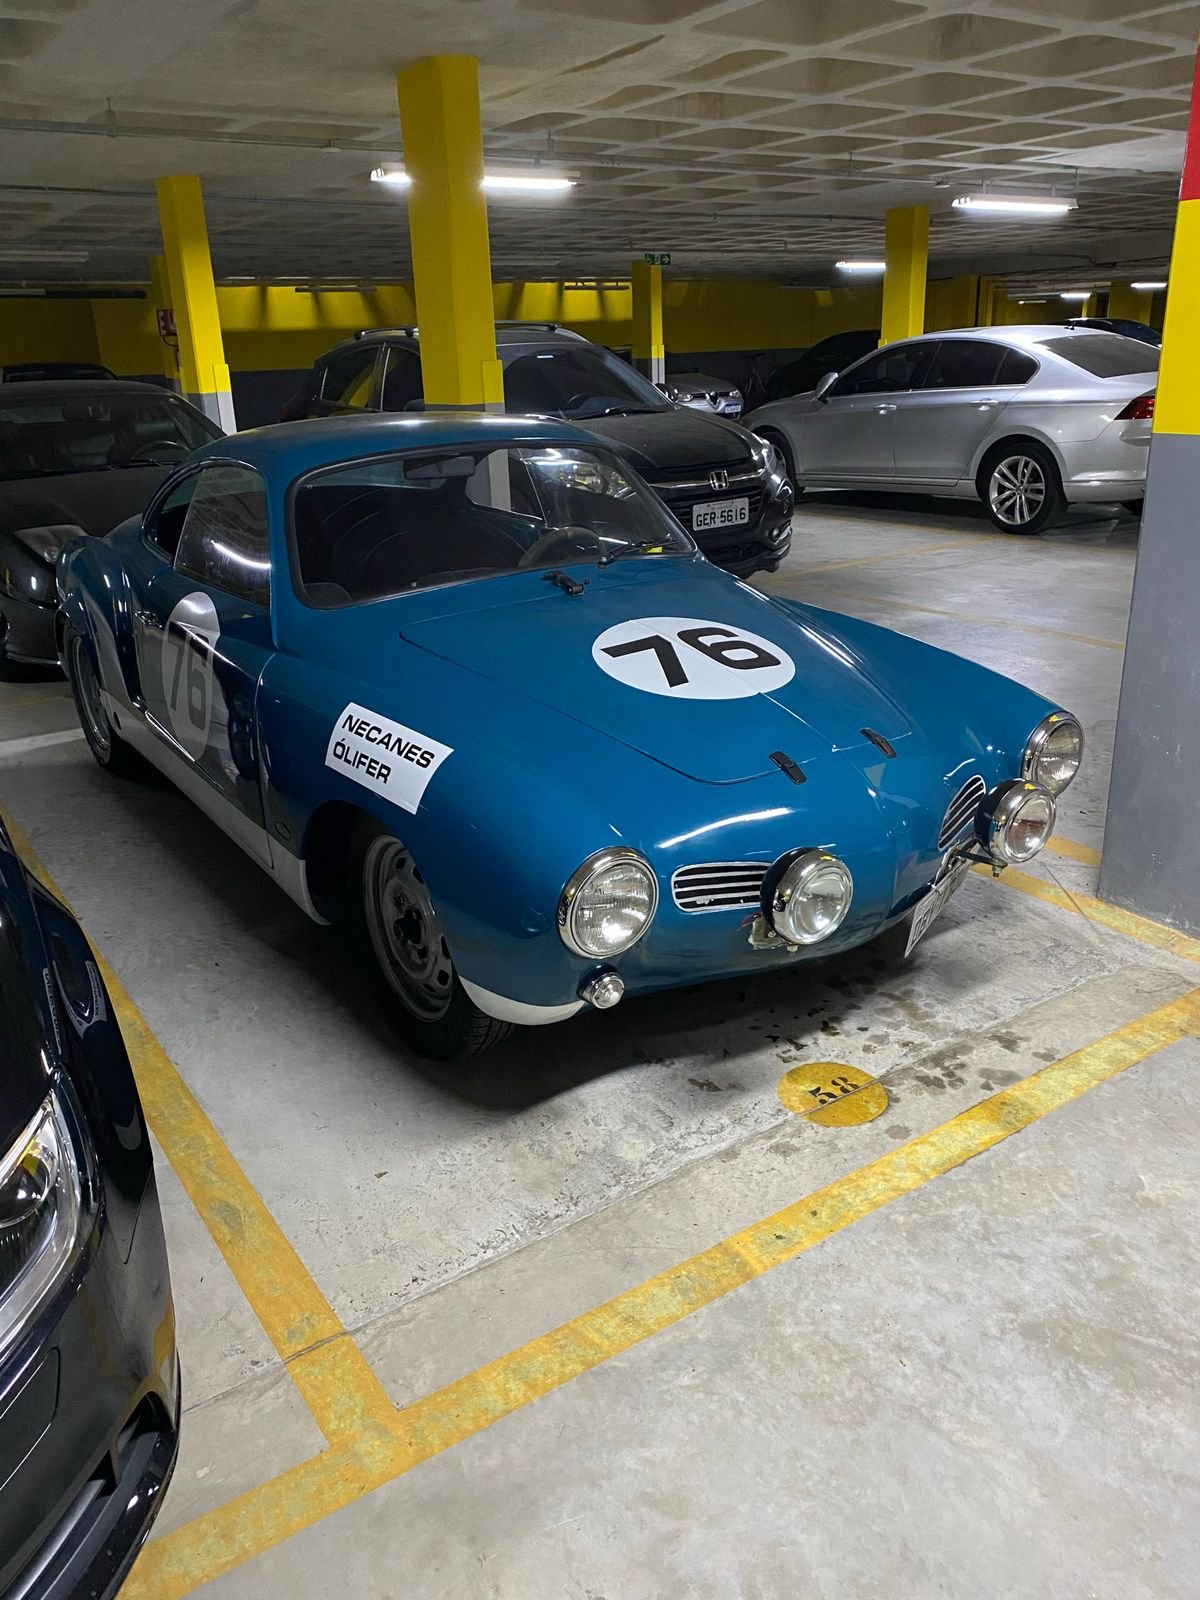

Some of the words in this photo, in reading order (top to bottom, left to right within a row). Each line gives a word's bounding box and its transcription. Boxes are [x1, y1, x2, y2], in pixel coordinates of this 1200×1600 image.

[167, 620, 211, 731] 76
[600, 627, 781, 688] 76
[332, 738, 392, 785] ÓLIFER
[341, 714, 436, 769] NECANES
[808, 1076, 861, 1105] 58
